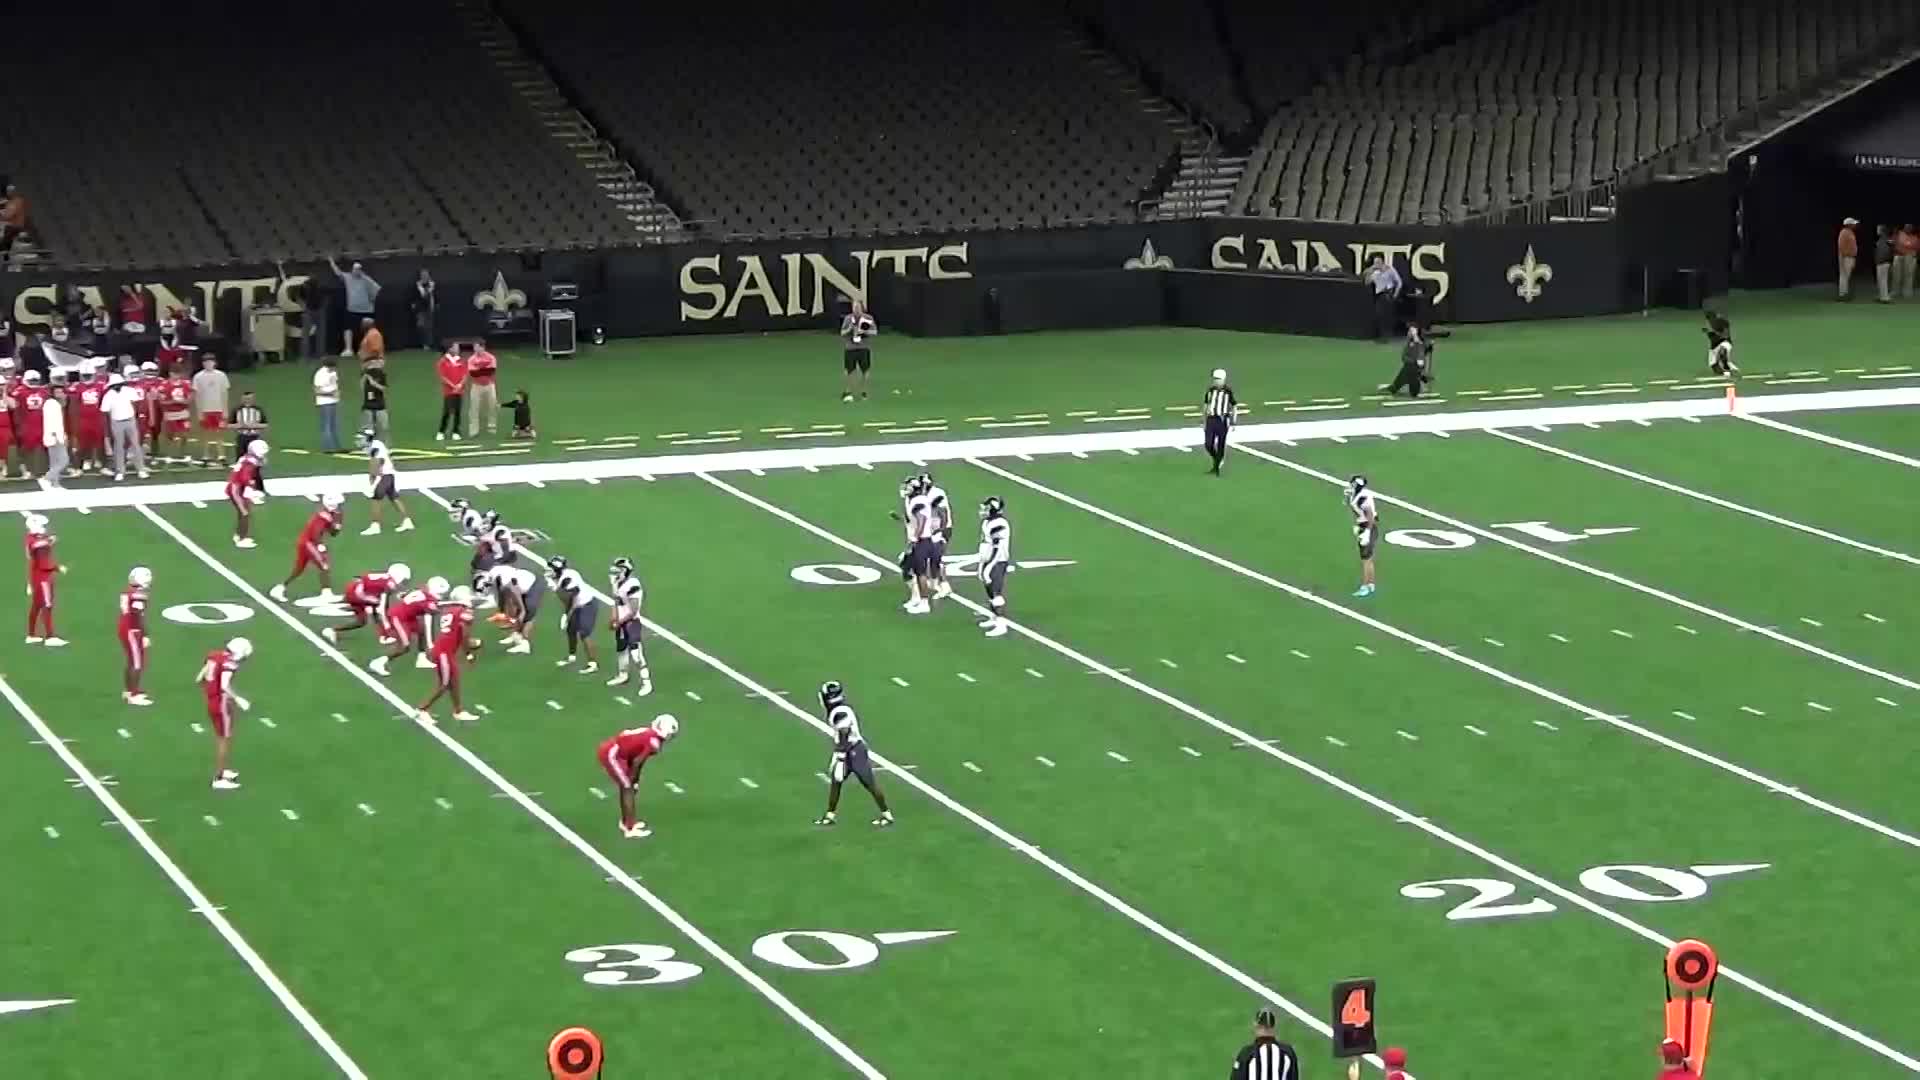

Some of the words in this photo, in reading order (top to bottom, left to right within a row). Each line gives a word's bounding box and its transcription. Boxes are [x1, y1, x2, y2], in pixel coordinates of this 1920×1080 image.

[1400, 863, 1708, 920] 20
[564, 929, 880, 986] 30
[1341, 989, 1371, 1028] 4
